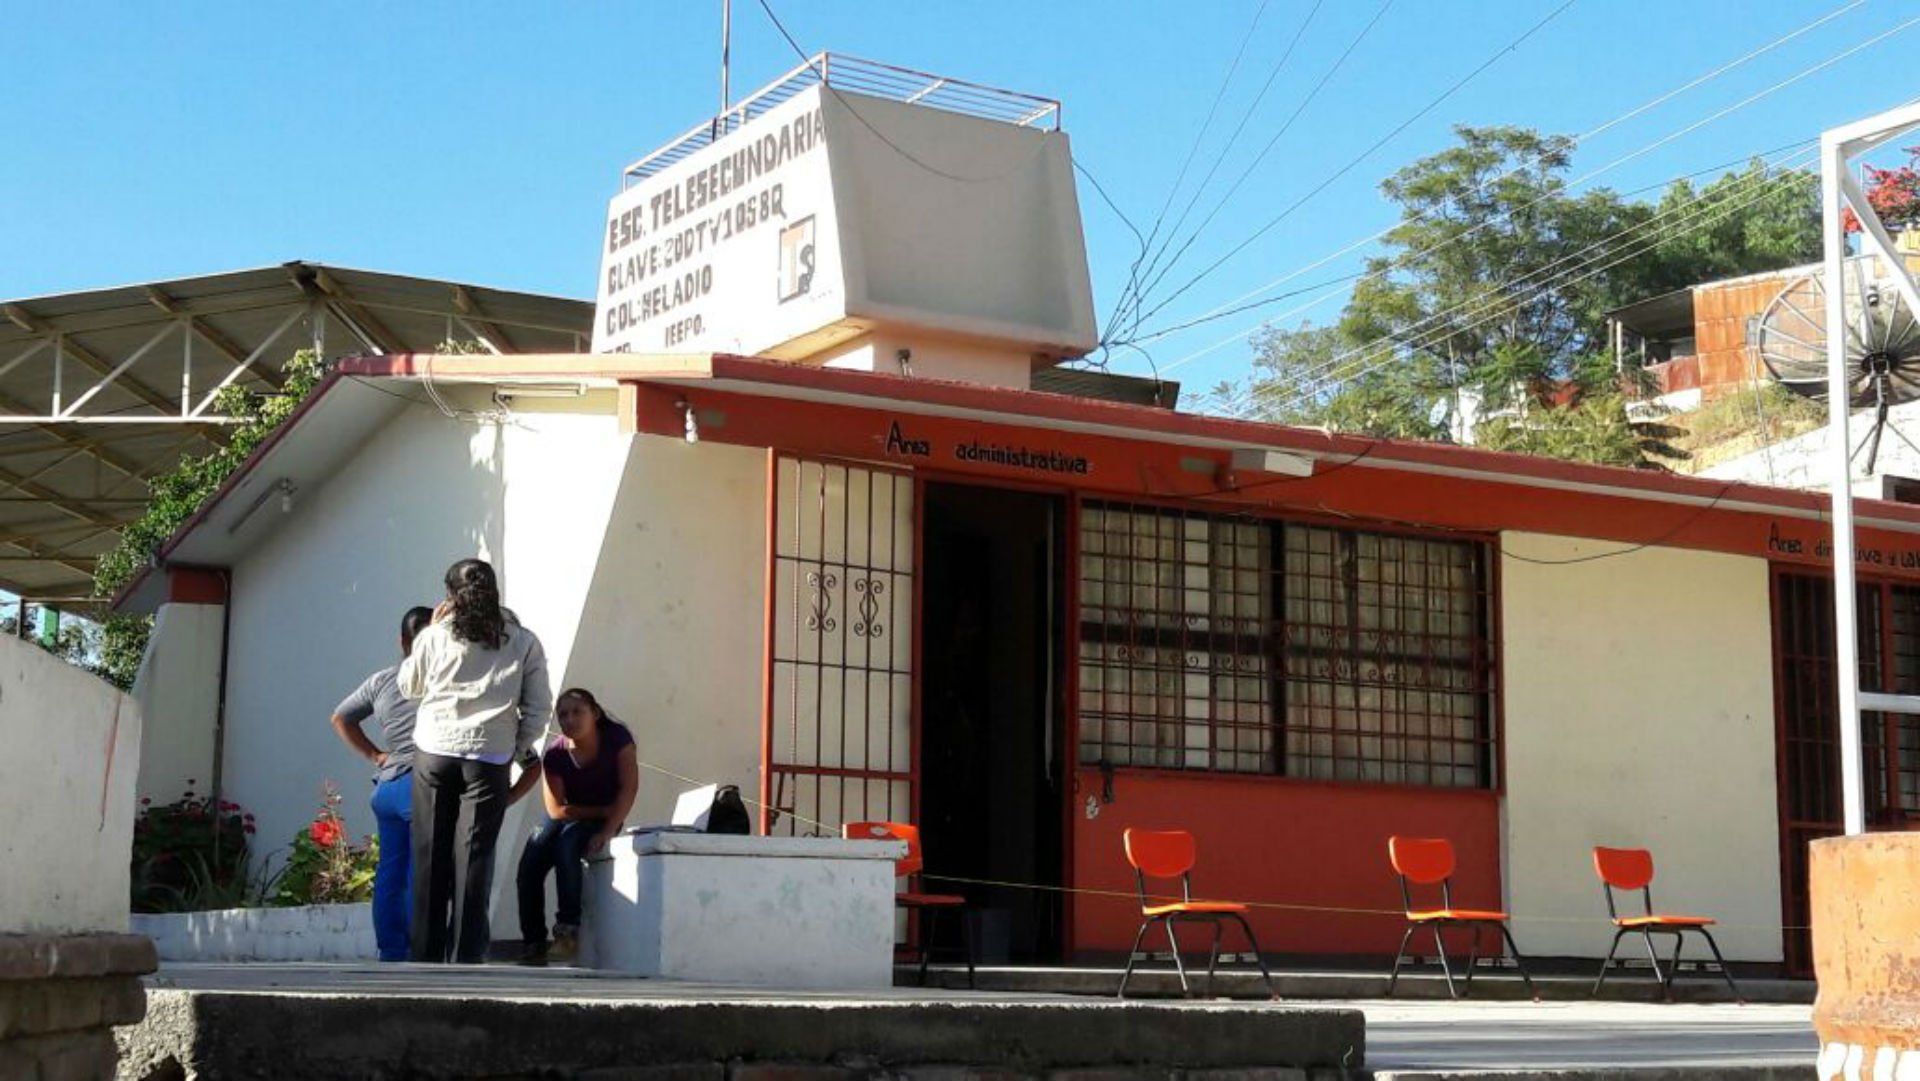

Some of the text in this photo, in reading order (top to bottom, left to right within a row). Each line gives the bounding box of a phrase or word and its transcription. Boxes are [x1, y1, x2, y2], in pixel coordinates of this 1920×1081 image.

[609, 108, 826, 254] ESC. TELESECUNDARIA
[954, 439, 1088, 475] administrativa
